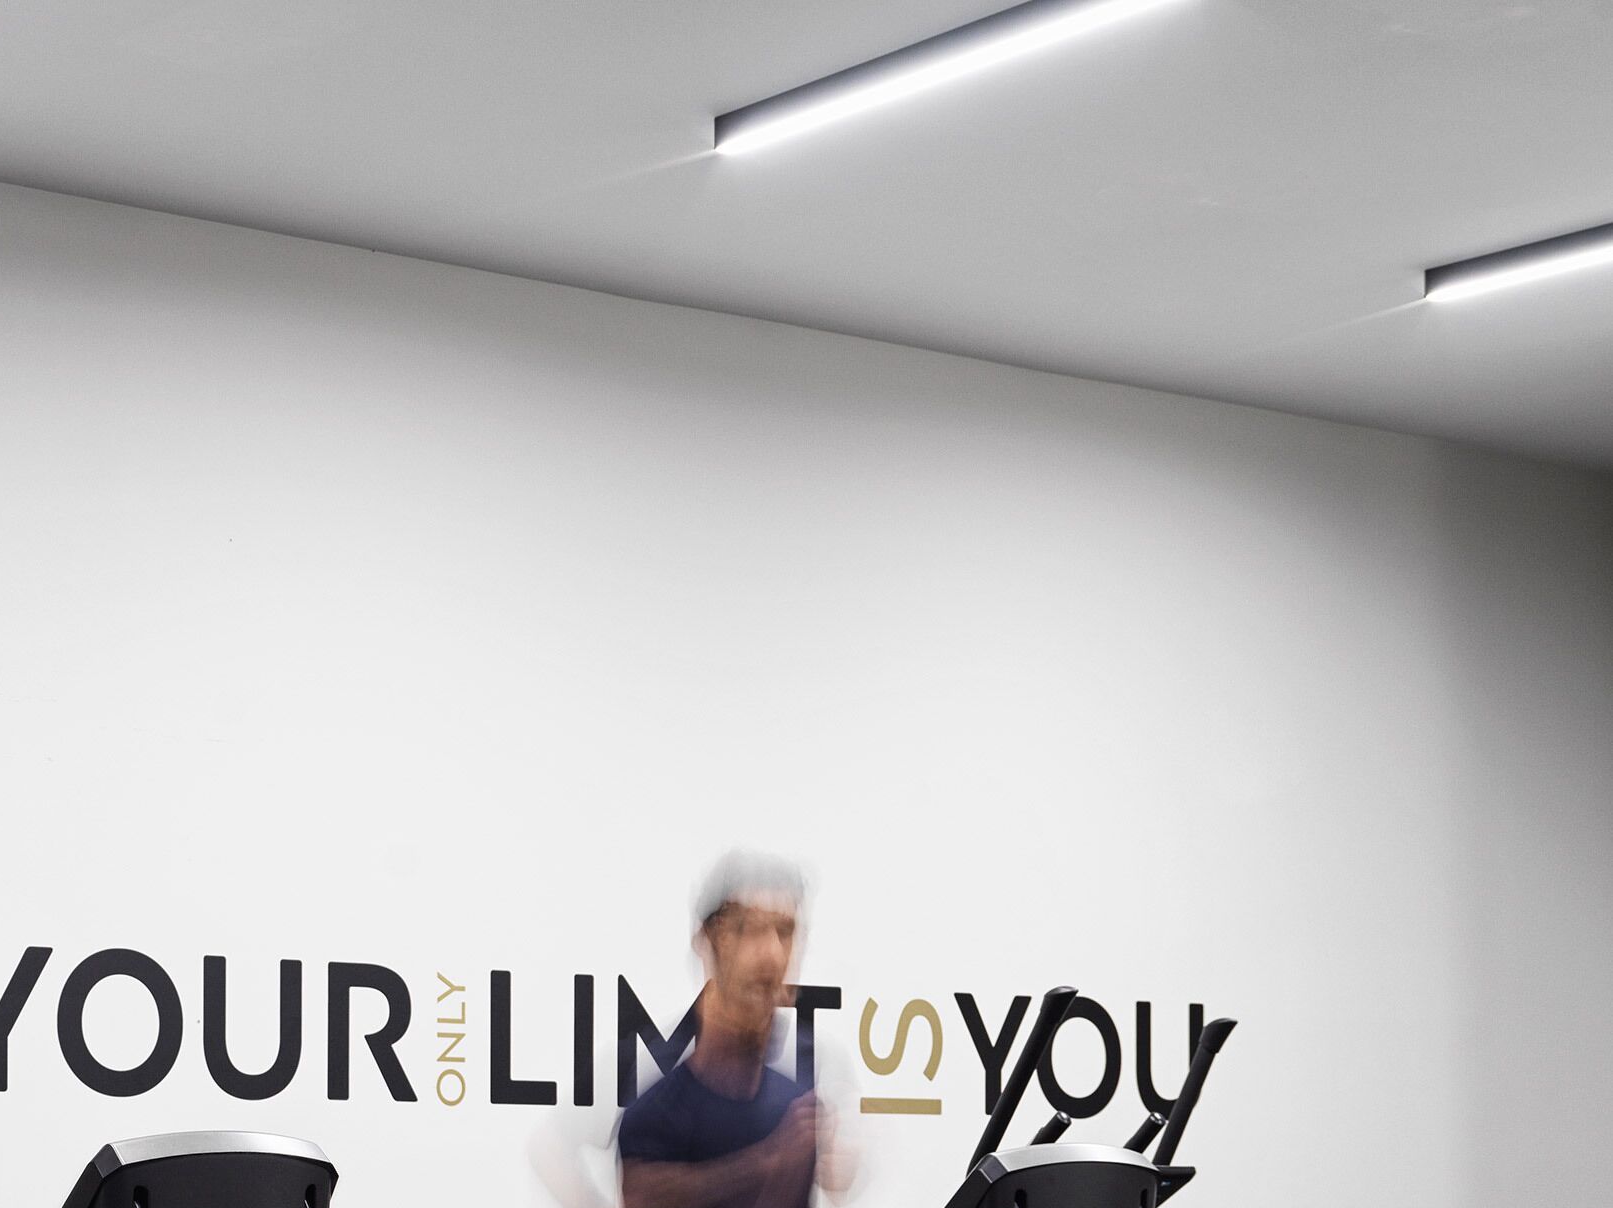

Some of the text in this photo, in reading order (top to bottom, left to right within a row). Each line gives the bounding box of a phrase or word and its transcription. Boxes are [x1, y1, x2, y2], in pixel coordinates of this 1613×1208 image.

[436, 971, 466, 1107] ONLY
[490, 969, 842, 1108] LIMT
[859, 997, 943, 1115] IS
[954, 992, 1205, 1119] YOU
